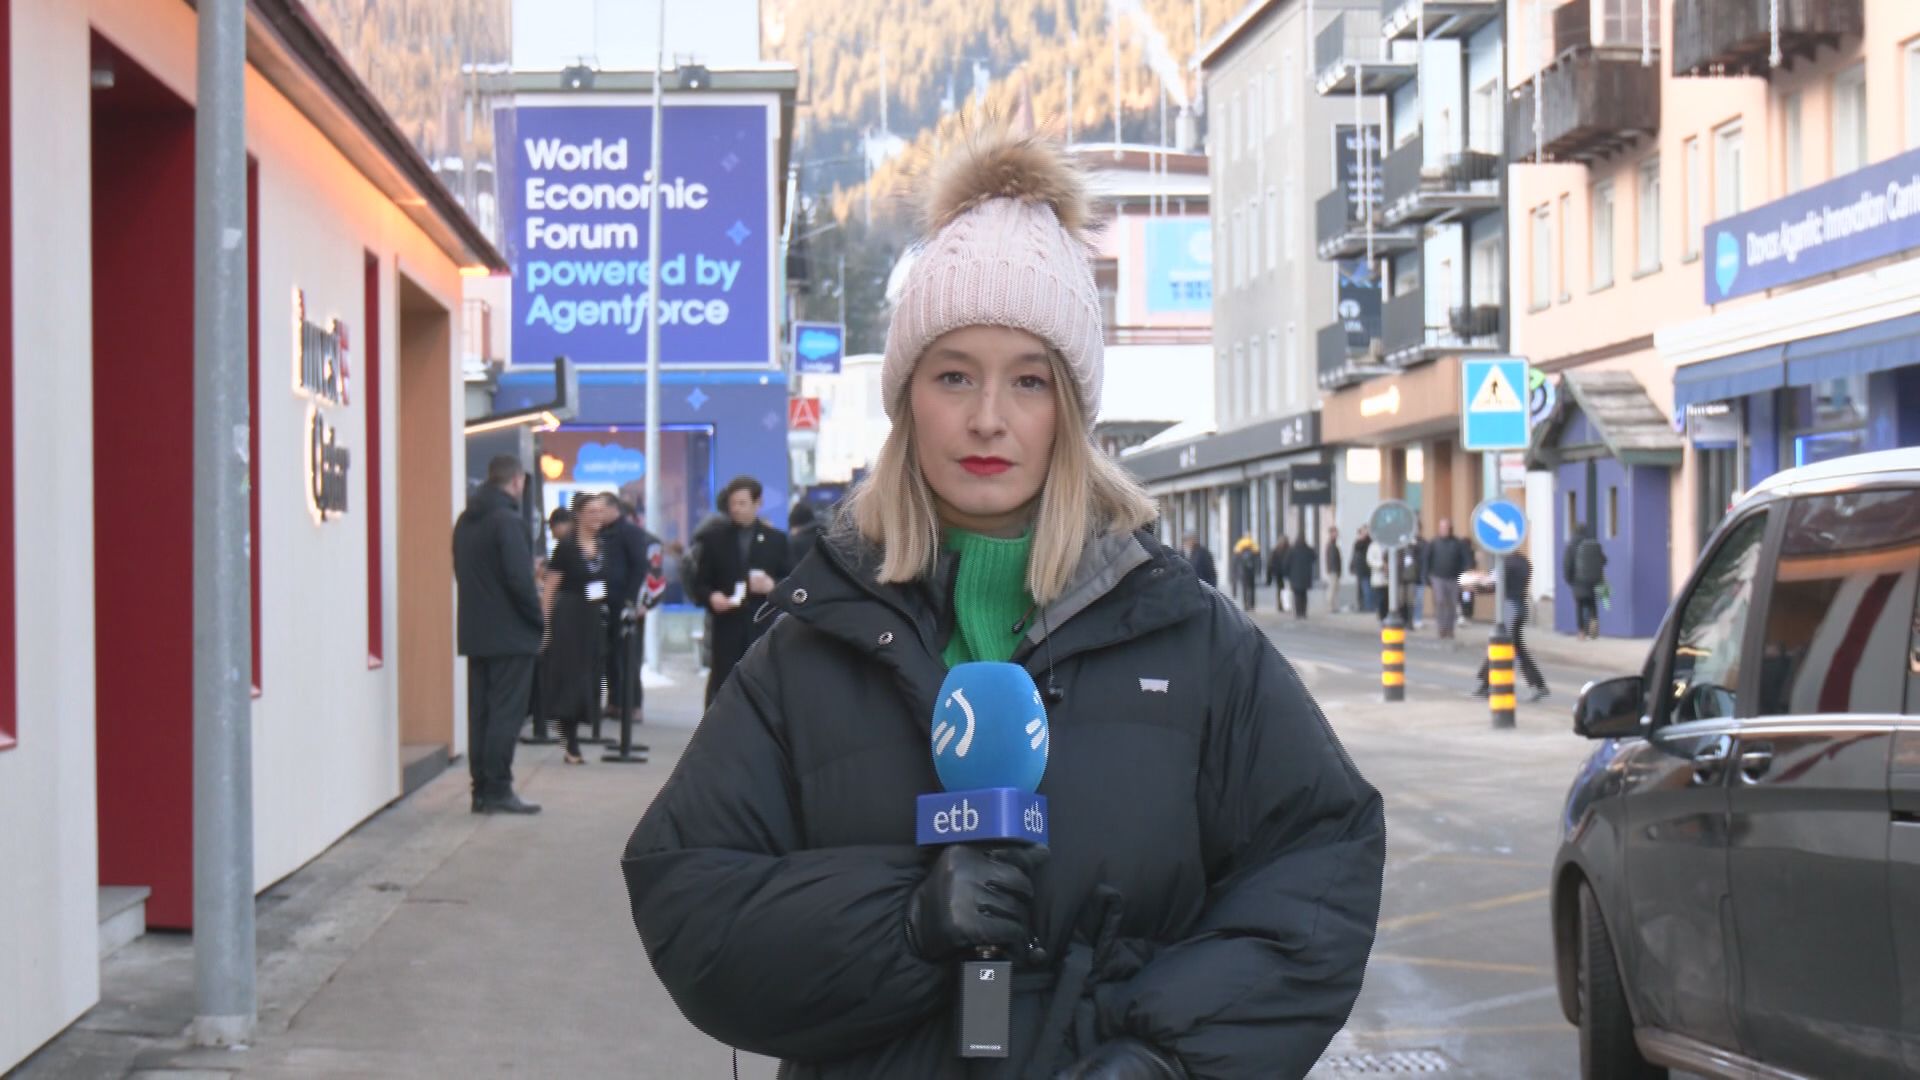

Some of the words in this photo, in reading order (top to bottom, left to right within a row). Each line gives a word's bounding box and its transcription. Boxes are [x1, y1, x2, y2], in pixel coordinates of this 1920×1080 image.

[525, 138, 627, 171] World
[526, 170, 709, 211] Economic
[526, 217, 638, 249] Forum
[1747, 232, 1779, 266] Davos
[1779, 211, 1823, 263] Agentic
[1823, 191, 1887, 241] Innovation
[1887, 174, 1920, 221] Cent
[527, 254, 686, 293] powered
[695, 254, 742, 292] by
[525, 291, 730, 334] Agentforce
[933, 798, 979, 833] etb
[1023, 801, 1043, 833] etb
